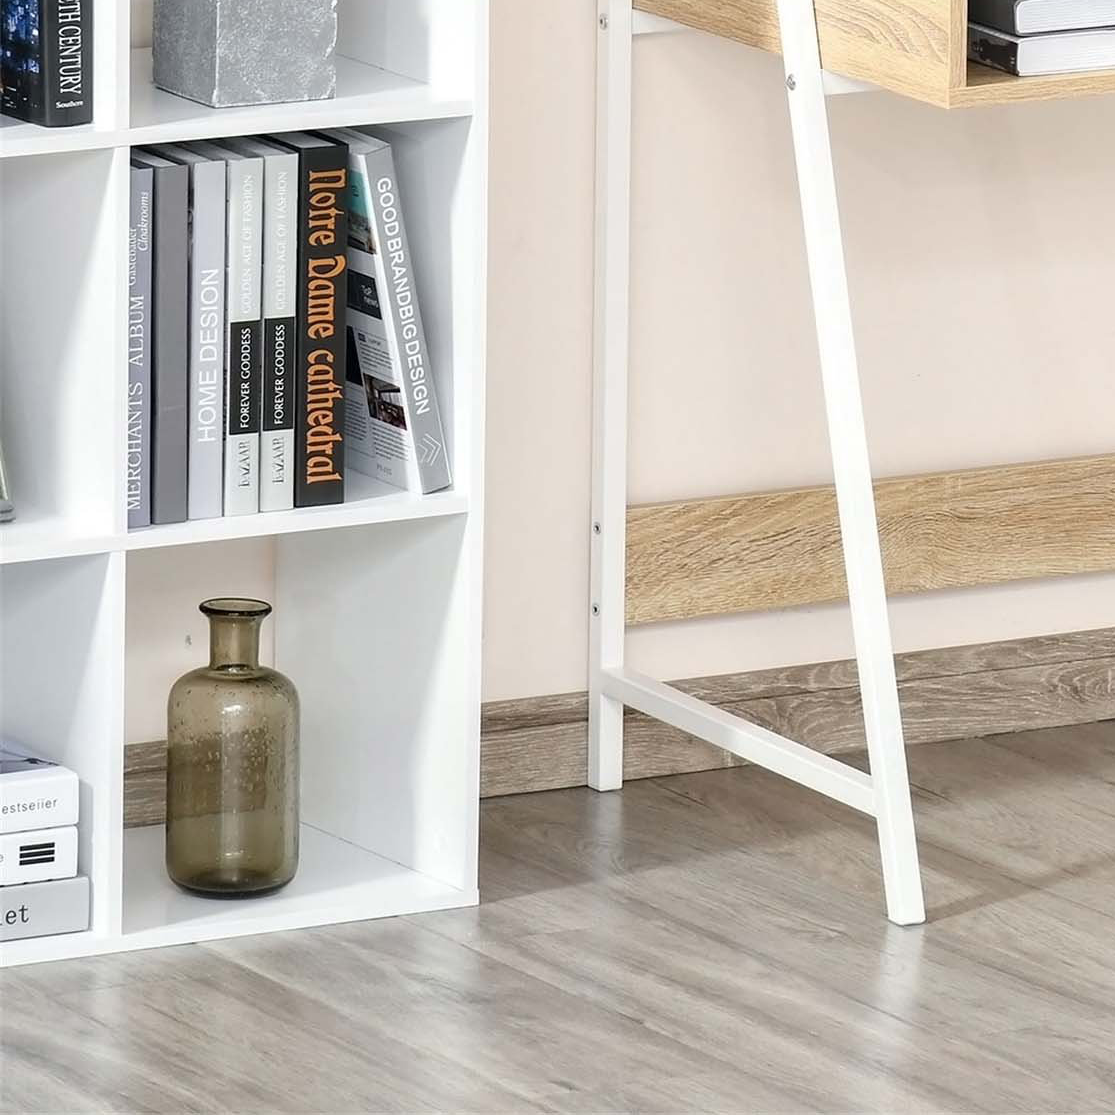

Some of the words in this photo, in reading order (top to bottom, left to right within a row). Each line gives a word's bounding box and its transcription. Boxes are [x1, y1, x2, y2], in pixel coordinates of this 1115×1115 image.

[58, 25, 82, 94] CENTURY
[137, 191, 149, 252] Cloakrooms
[308, 168, 346, 246] Notre
[129, 296, 144, 366] ALBUM
[307, 254, 346, 340] Dame
[241, 328, 251, 380] GODDESS
[275, 324, 285, 376] GODDESS
[197, 370, 217, 442] HOME
[240, 384, 250, 428] FOREVER
[274, 378, 284, 424] FOREVER
[306, 349, 343, 485] cathedral
[127, 382, 143, 510] MERCHANTS
